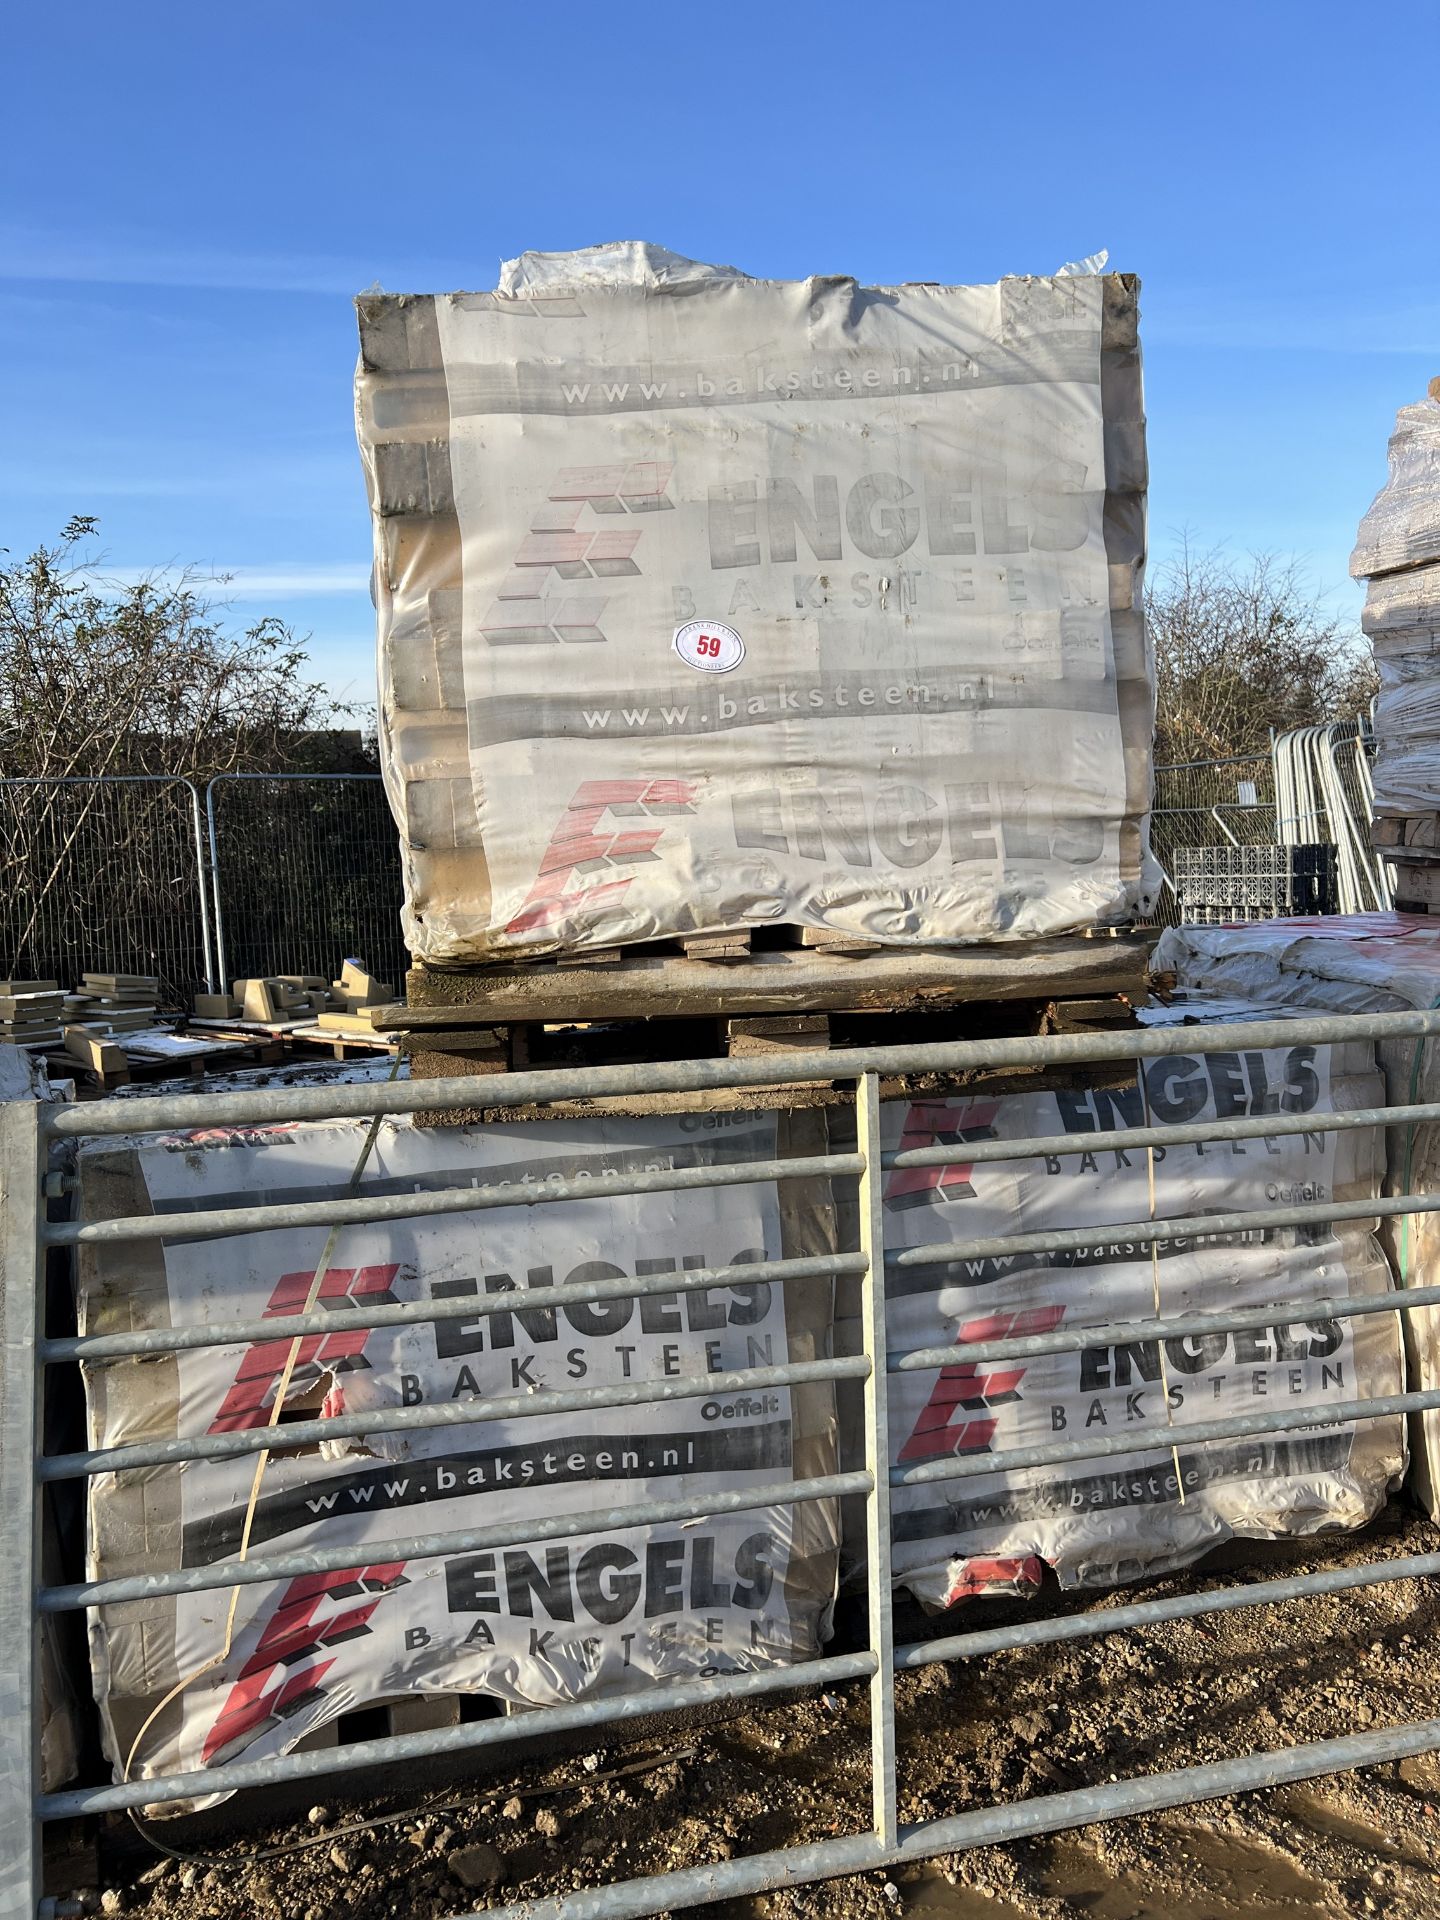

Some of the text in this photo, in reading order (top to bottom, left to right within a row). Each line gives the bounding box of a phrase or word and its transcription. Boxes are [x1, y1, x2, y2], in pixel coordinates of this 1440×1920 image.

[561, 360, 980, 404] www.baksteen.nl
[708, 462, 1090, 570] ENGELS
[697, 634, 721, 657] 59
[582, 674, 995, 729] www.baksteen.nl
[731, 779, 1106, 868] ENGELS
[1055, 1045, 1320, 1133] ENGELS
[430, 1248, 773, 1359] ENGELS
[401, 1334, 774, 1407] BAKSTEEN
[1051, 1362, 1345, 1431] BAKSTEEN
[701, 1395, 779, 1421] Oeffelt
[305, 1441, 695, 1514] www.baksteen.nl
[972, 1450, 1276, 1522] www.baksteen.nl
[445, 1531, 774, 1624] ENGELS
